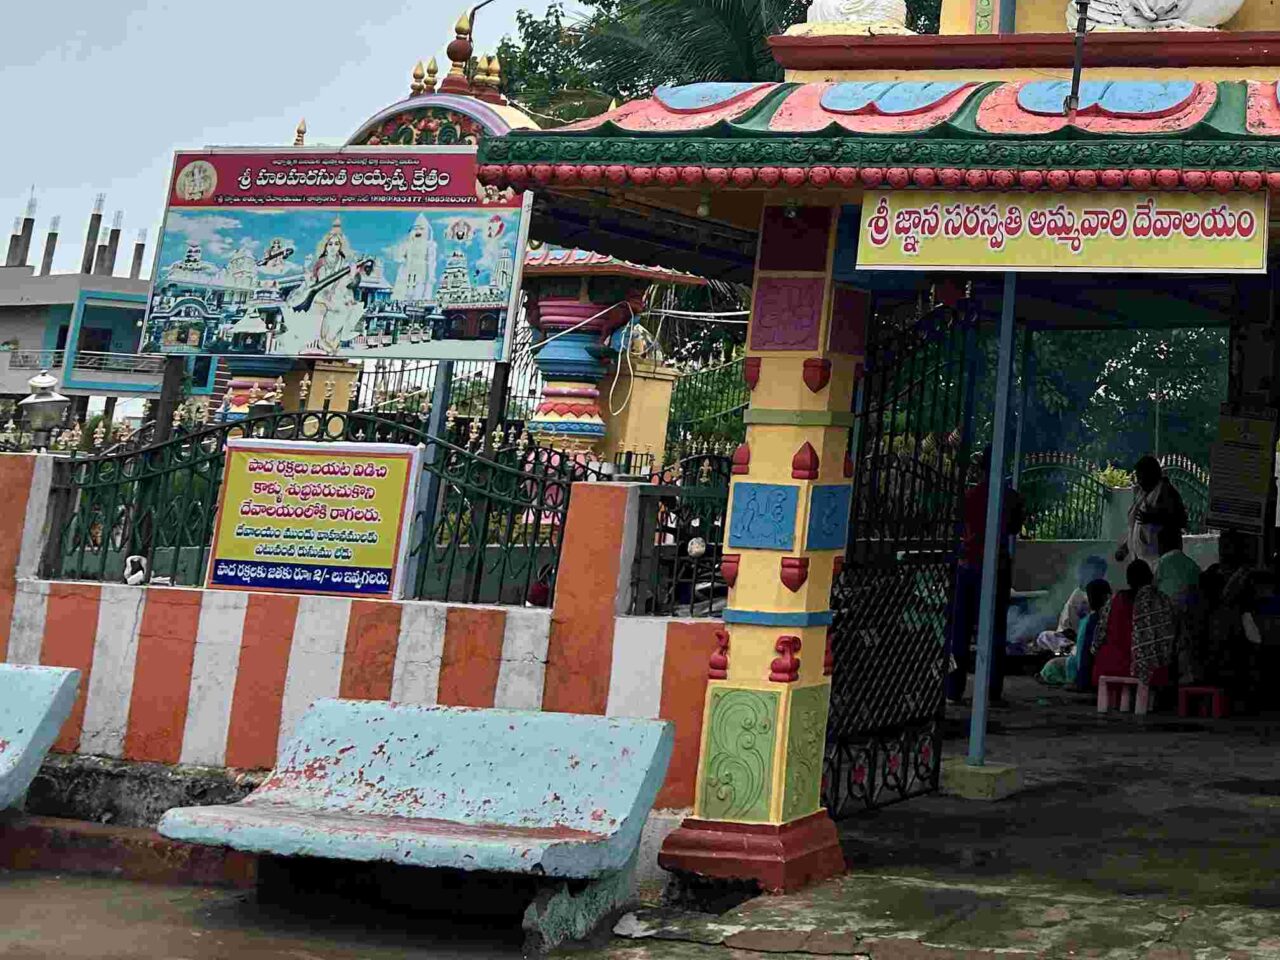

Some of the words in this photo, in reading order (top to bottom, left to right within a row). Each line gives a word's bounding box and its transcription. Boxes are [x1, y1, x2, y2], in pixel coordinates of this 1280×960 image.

[237, 167, 252, 190] శ్రీ
[351, 169, 408, 190] అయ్యప్ప
[410, 167, 451, 192] క్షేత్రం
[867, 197, 889, 246] శ్రీ
[943, 201, 1024, 250] సరస్వతి
[1027, 203, 1128, 252] అమ్మవారి
[1131, 198, 1256, 238] దేవాలయం
[248, 458, 274, 473] పాద
[276, 460, 309, 479] రక్షలు
[310, 461, 351, 476] బయట
[353, 463, 387, 478] విడిచి
[240, 499, 327, 520] దేవాలయంలోకి
